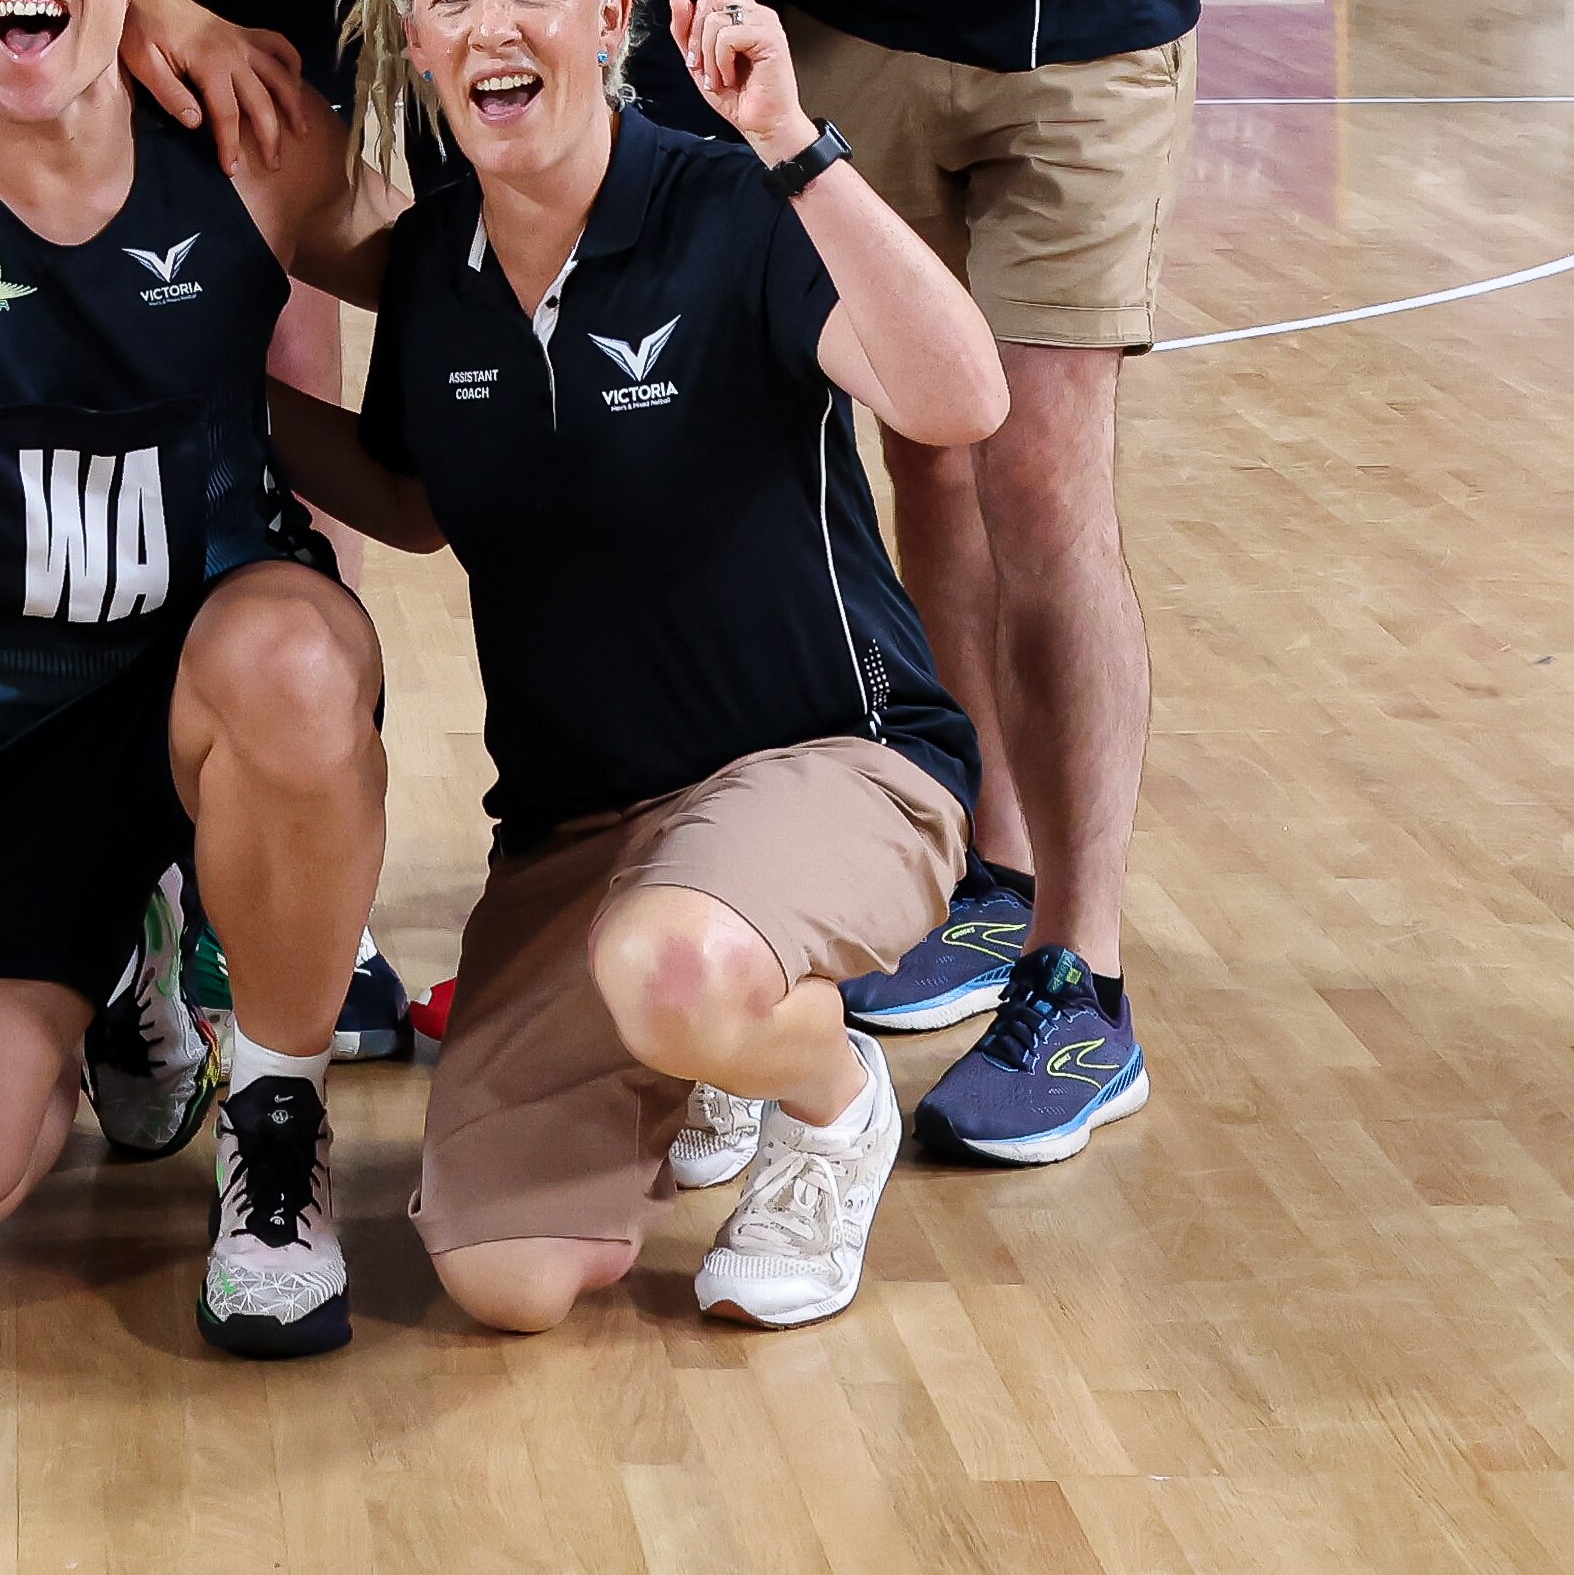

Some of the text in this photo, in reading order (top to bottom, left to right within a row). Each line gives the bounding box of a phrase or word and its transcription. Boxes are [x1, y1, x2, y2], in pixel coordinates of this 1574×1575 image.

[140, 281, 203, 302] VICTORIA
[449, 369, 499, 384] ASSISTANT
[455, 386, 490, 400] COACH
[601, 381, 679, 406] VICTORIA
[19, 446, 170, 623] WA
